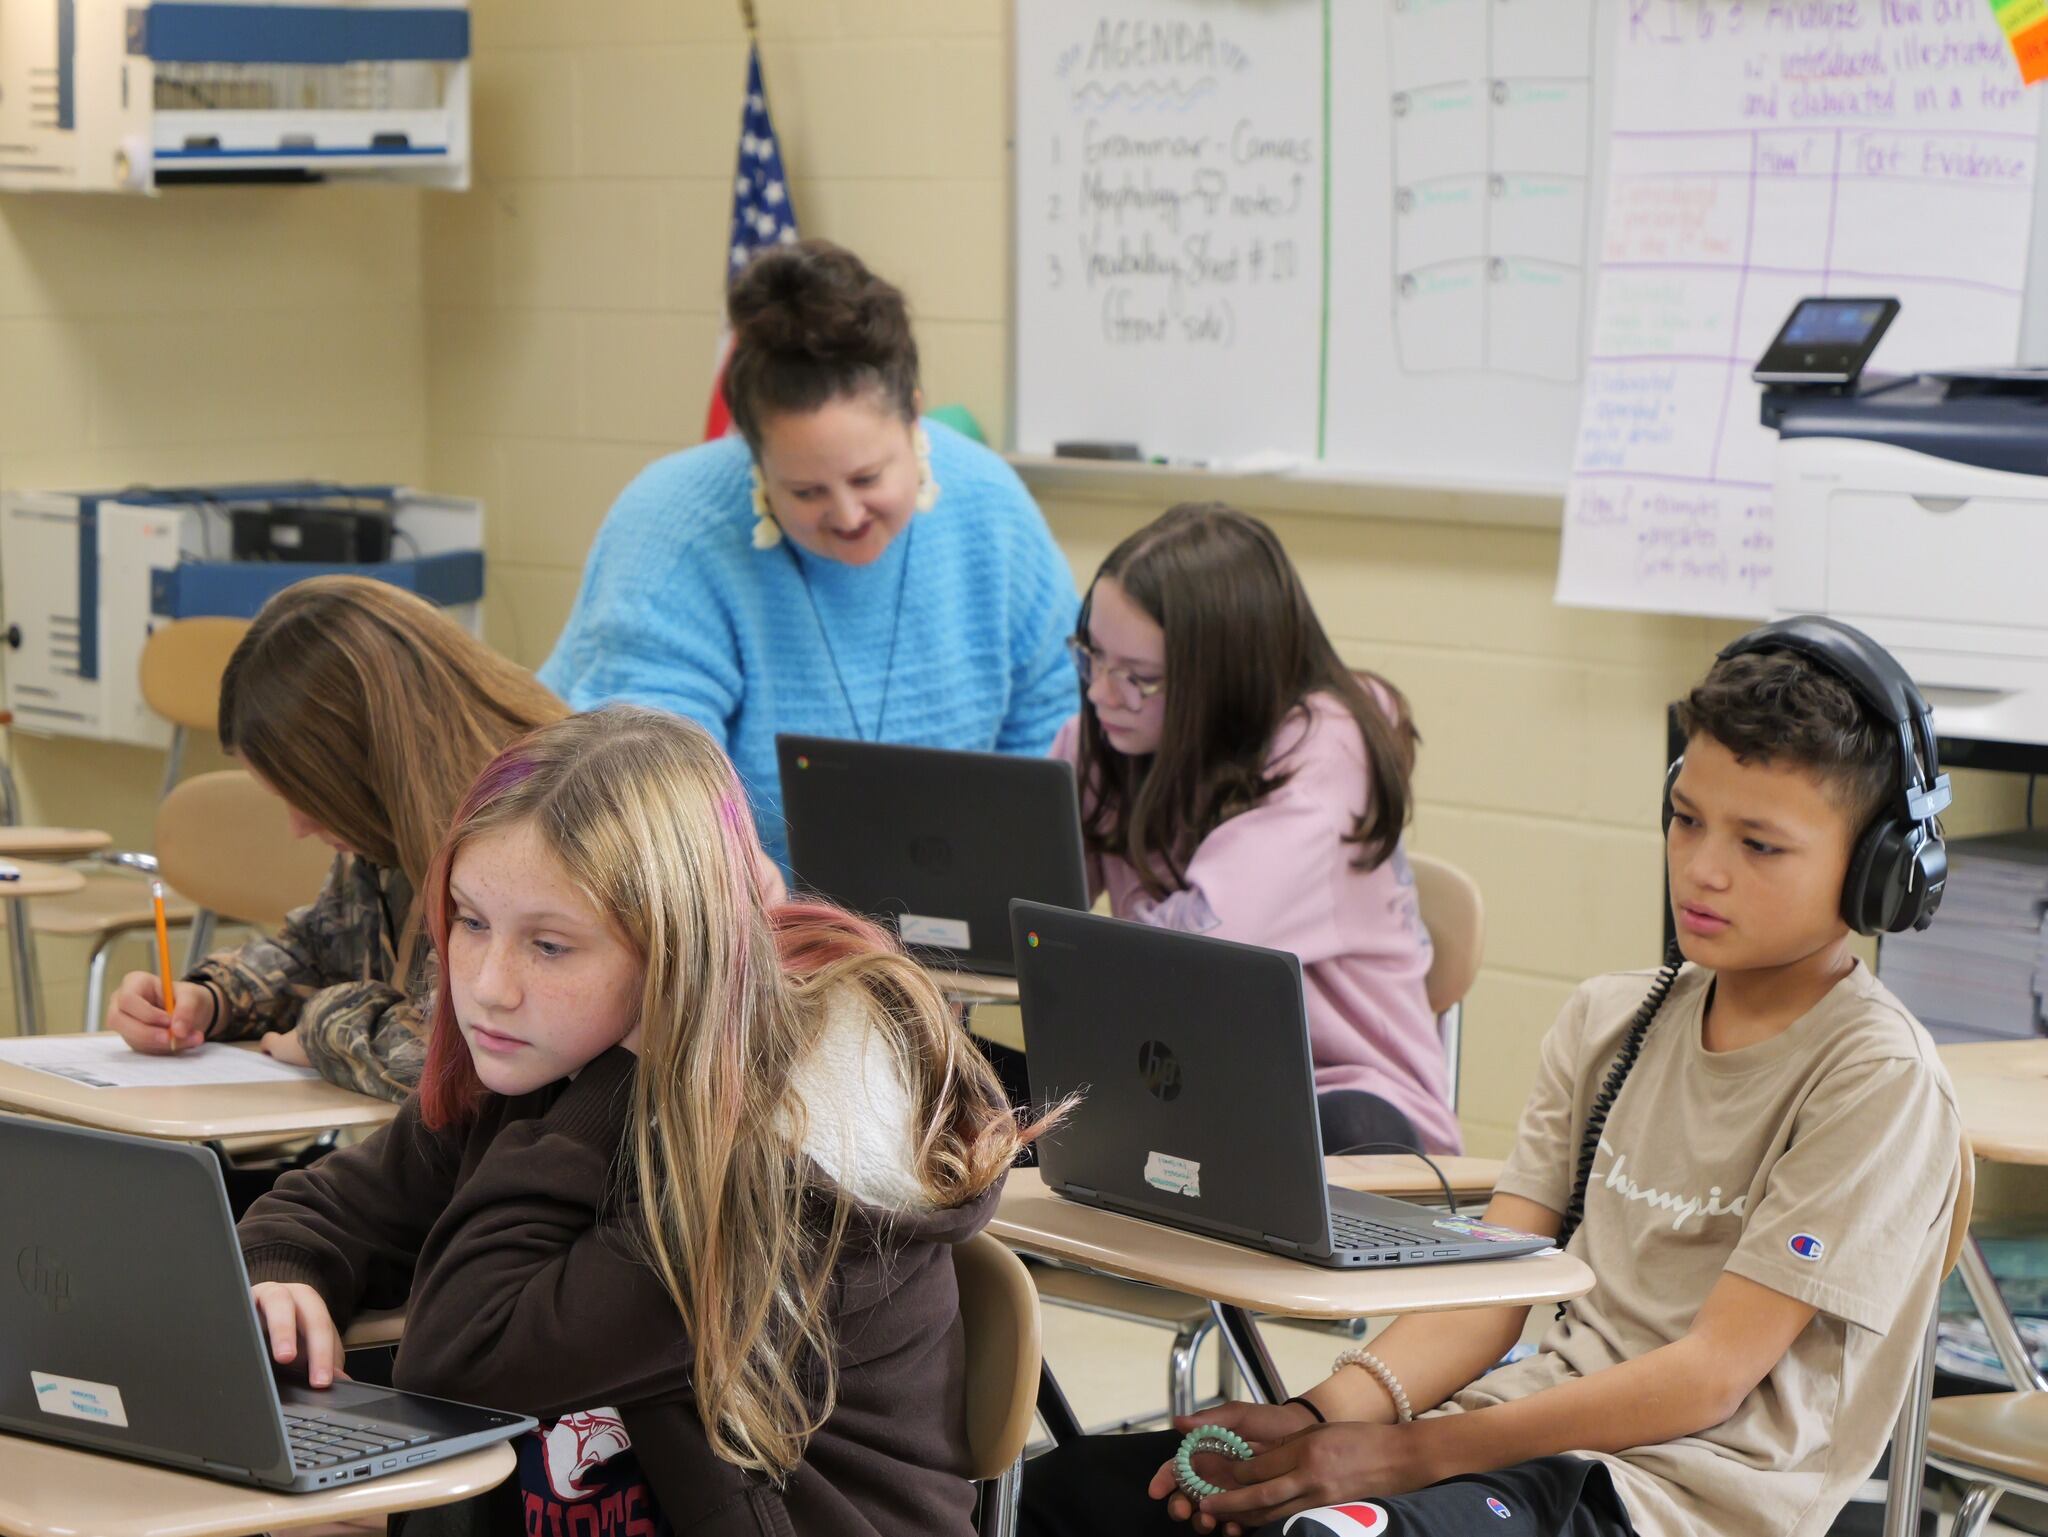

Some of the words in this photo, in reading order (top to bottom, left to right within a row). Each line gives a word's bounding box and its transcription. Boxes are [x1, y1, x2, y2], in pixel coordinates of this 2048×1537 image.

[1087, 17, 1216, 70] AGENDA
[1921, 137, 2026, 178] Evidence
[1148, 1040, 1178, 1101] hp
[33, 1245, 70, 1313] hp
